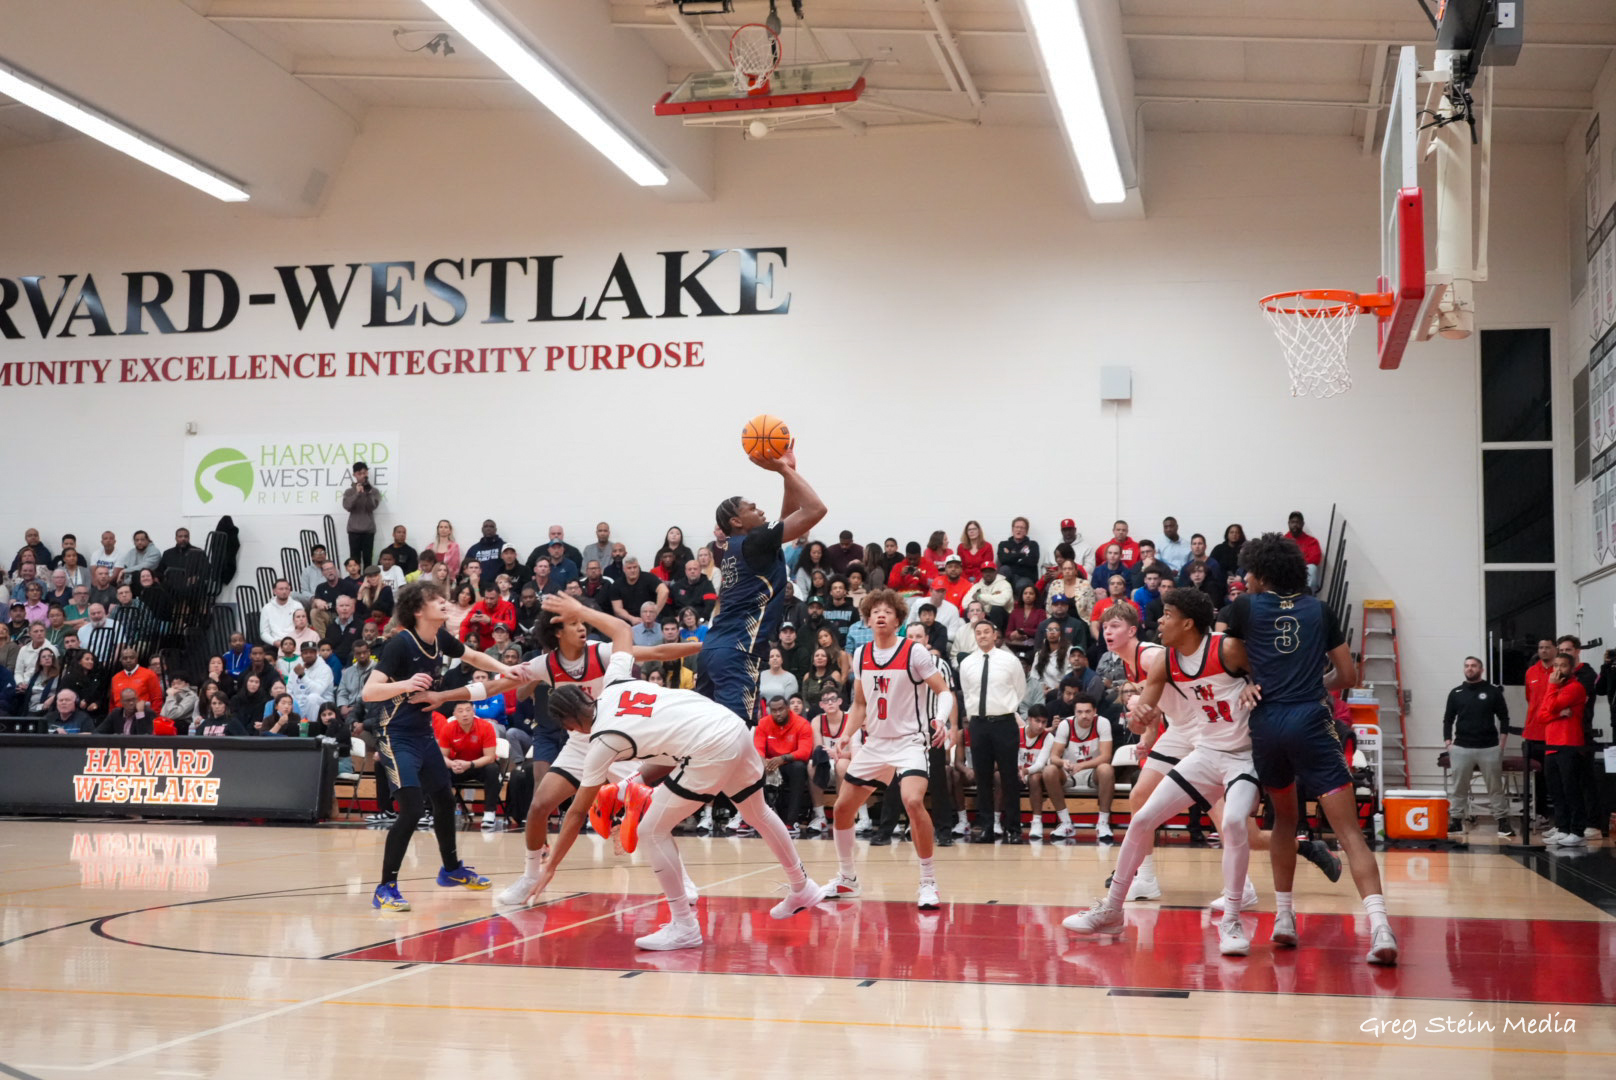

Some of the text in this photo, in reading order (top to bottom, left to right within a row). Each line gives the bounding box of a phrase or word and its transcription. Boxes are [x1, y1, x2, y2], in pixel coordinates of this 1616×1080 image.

[118, 352, 337, 383] EXCELLENCE
[346, 346, 536, 377] INTEGRITY
[544, 341, 706, 372] PURPOSE
[260, 442, 389, 466] HARVARD
[259, 467, 389, 488] WESTLAE
[257, 490, 389, 505] RIVER PK
[1274, 615, 1301, 654] 3
[614, 690, 658, 718] 15
[877, 697, 888, 720] 0
[83, 747, 215, 777] HARVARD
[73, 775, 221, 806] WESTLAKE
[1405, 806, 1429, 832] G
